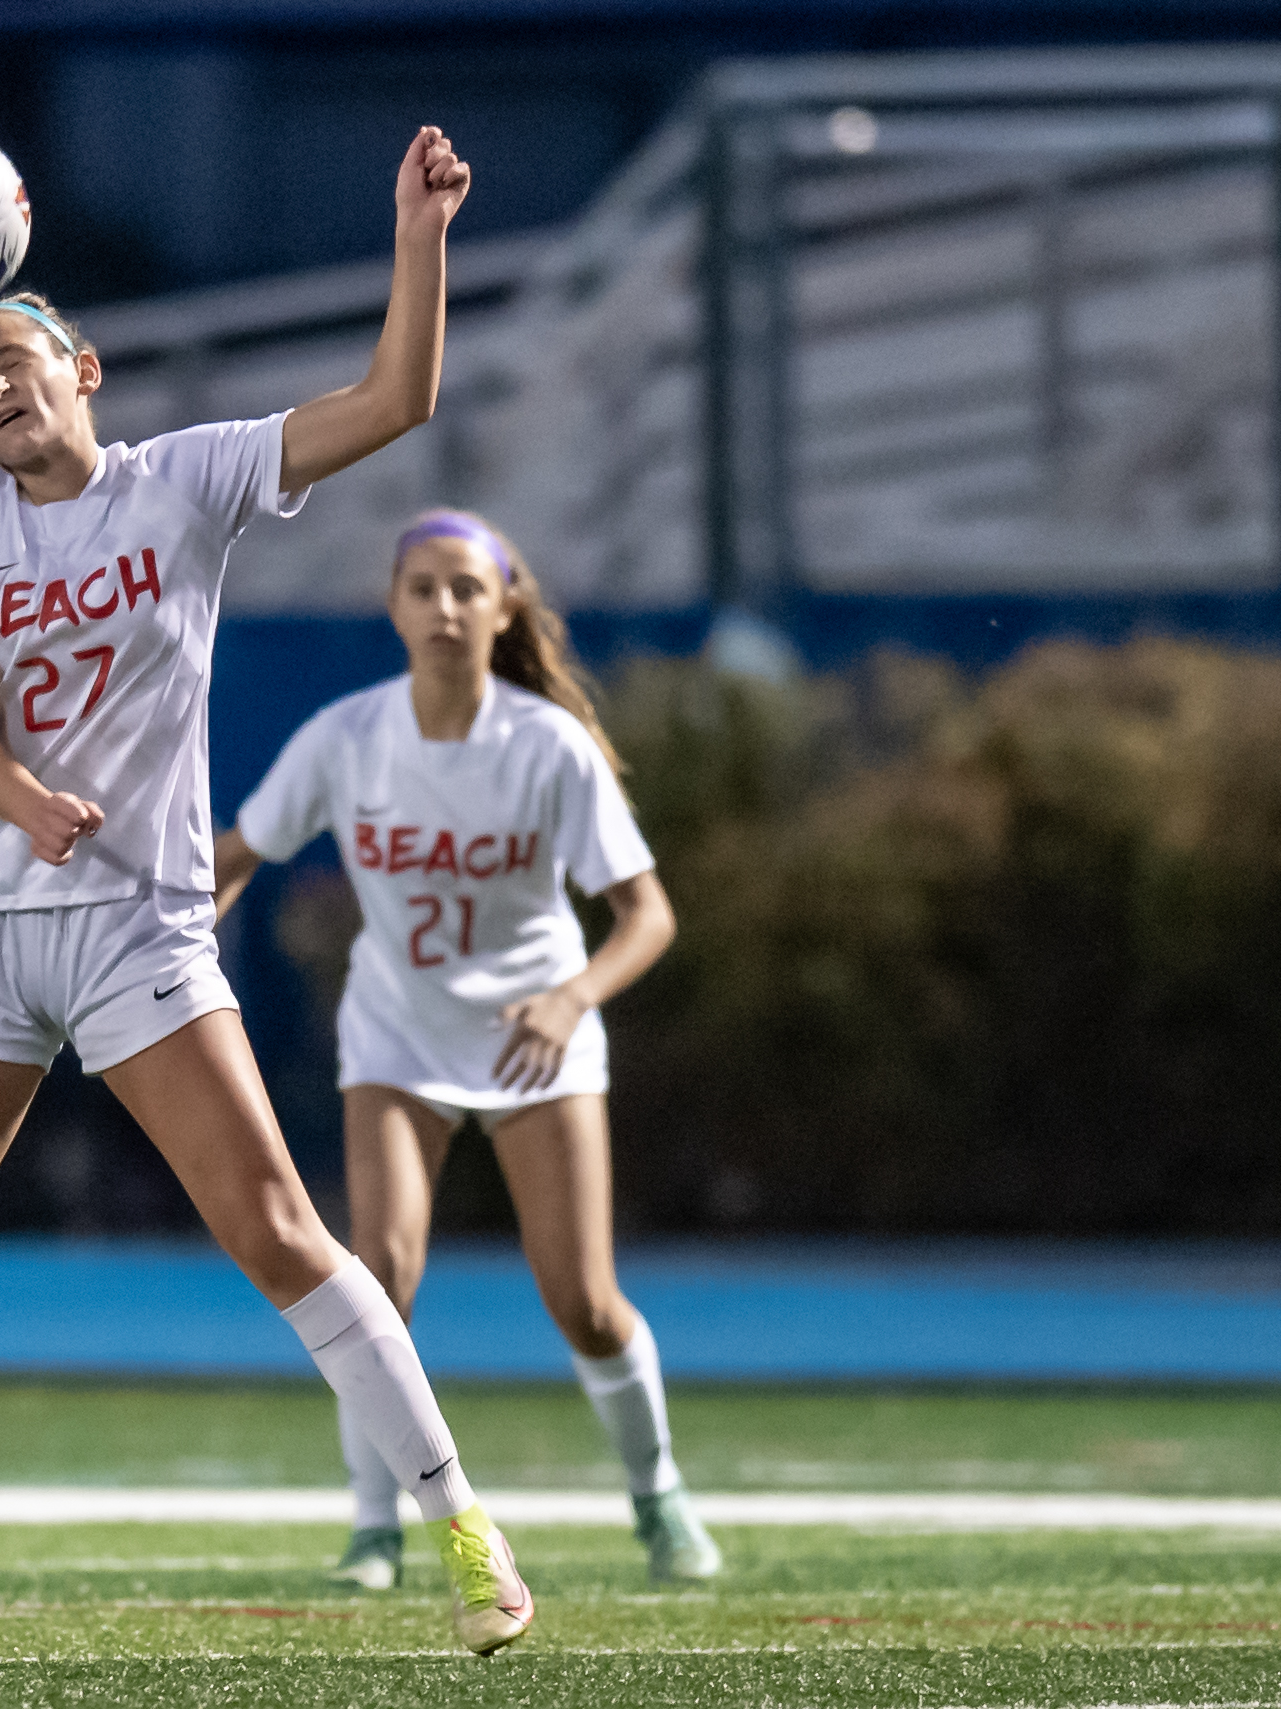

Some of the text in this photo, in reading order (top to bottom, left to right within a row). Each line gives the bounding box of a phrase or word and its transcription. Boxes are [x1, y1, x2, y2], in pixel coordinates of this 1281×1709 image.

[14, 644, 115, 734] 27
[355, 822, 538, 881] BEACH
[407, 894, 475, 968] 21
